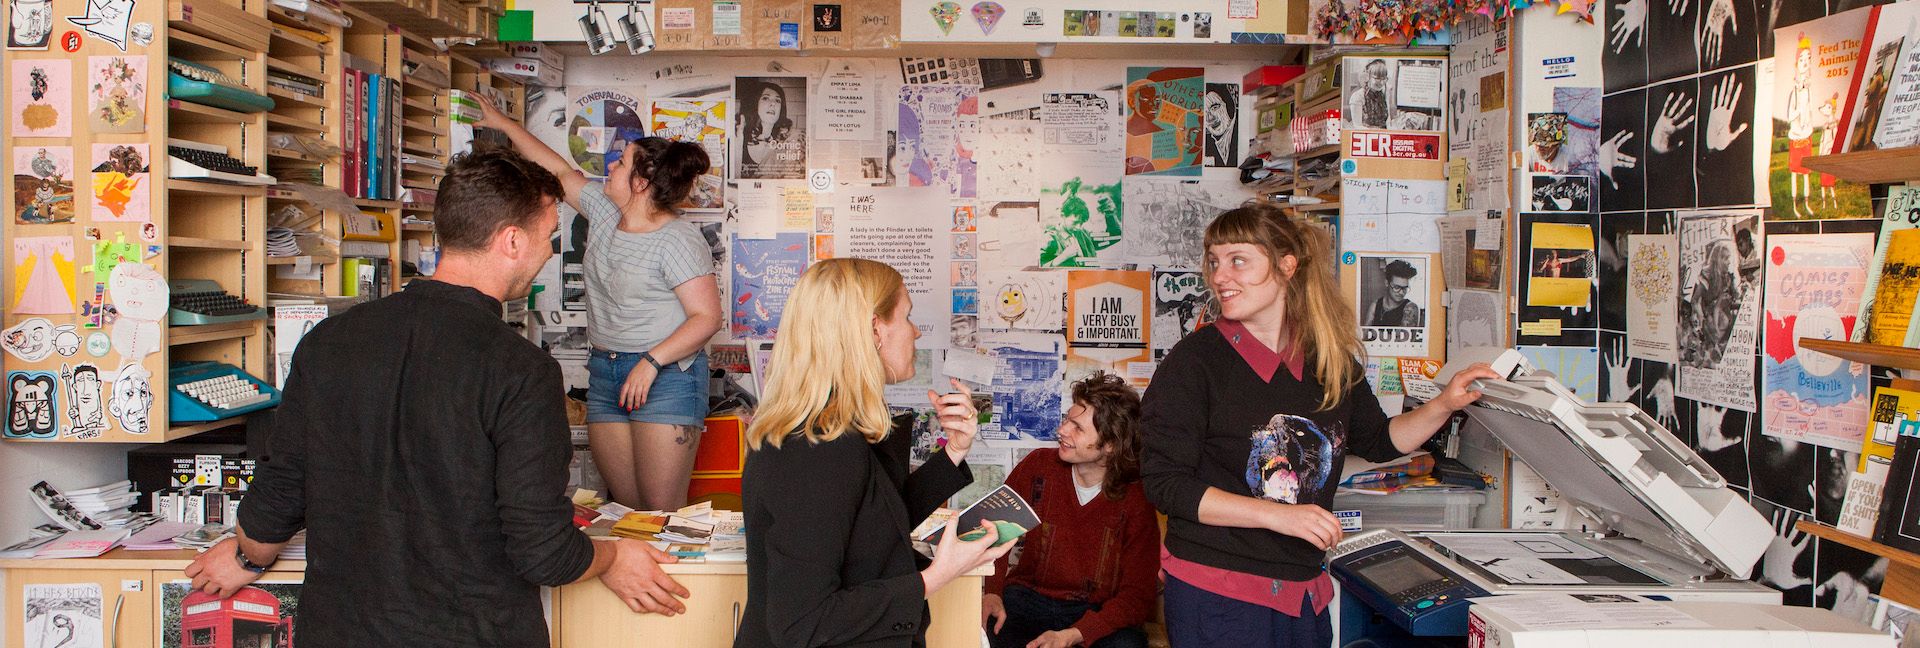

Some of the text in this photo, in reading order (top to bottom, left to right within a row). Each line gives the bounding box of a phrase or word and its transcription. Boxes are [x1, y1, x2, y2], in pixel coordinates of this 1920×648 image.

[1818, 39, 1861, 56] Feed The
[1818, 51, 1859, 67] Animals
[1826, 66, 1849, 78] 2015
[576, 90, 639, 112] TONERPALOOZA
[769, 139, 801, 150] Comic
[1352, 133, 1392, 157] 3CR
[776, 150, 801, 161] relief
[1392, 151, 1427, 159] 3cr.org.au
[857, 194, 876, 204] WAS
[850, 204, 874, 214] HERE
[915, 247, 931, 255] good
[765, 285, 782, 294] ZINE
[1092, 297, 1122, 314] I AM
[1082, 314, 1136, 327] VERY BUSY
[1077, 327, 1141, 340] & IMPORTANT.
[1361, 328, 1423, 343] DUDE
[1400, 359, 1421, 368] TEAM
[1401, 366, 1419, 374] PICK
[1851, 478, 1877, 496] OPEN
[1847, 489, 1857, 502] IF
[1840, 513, 1860, 530] DAY.
